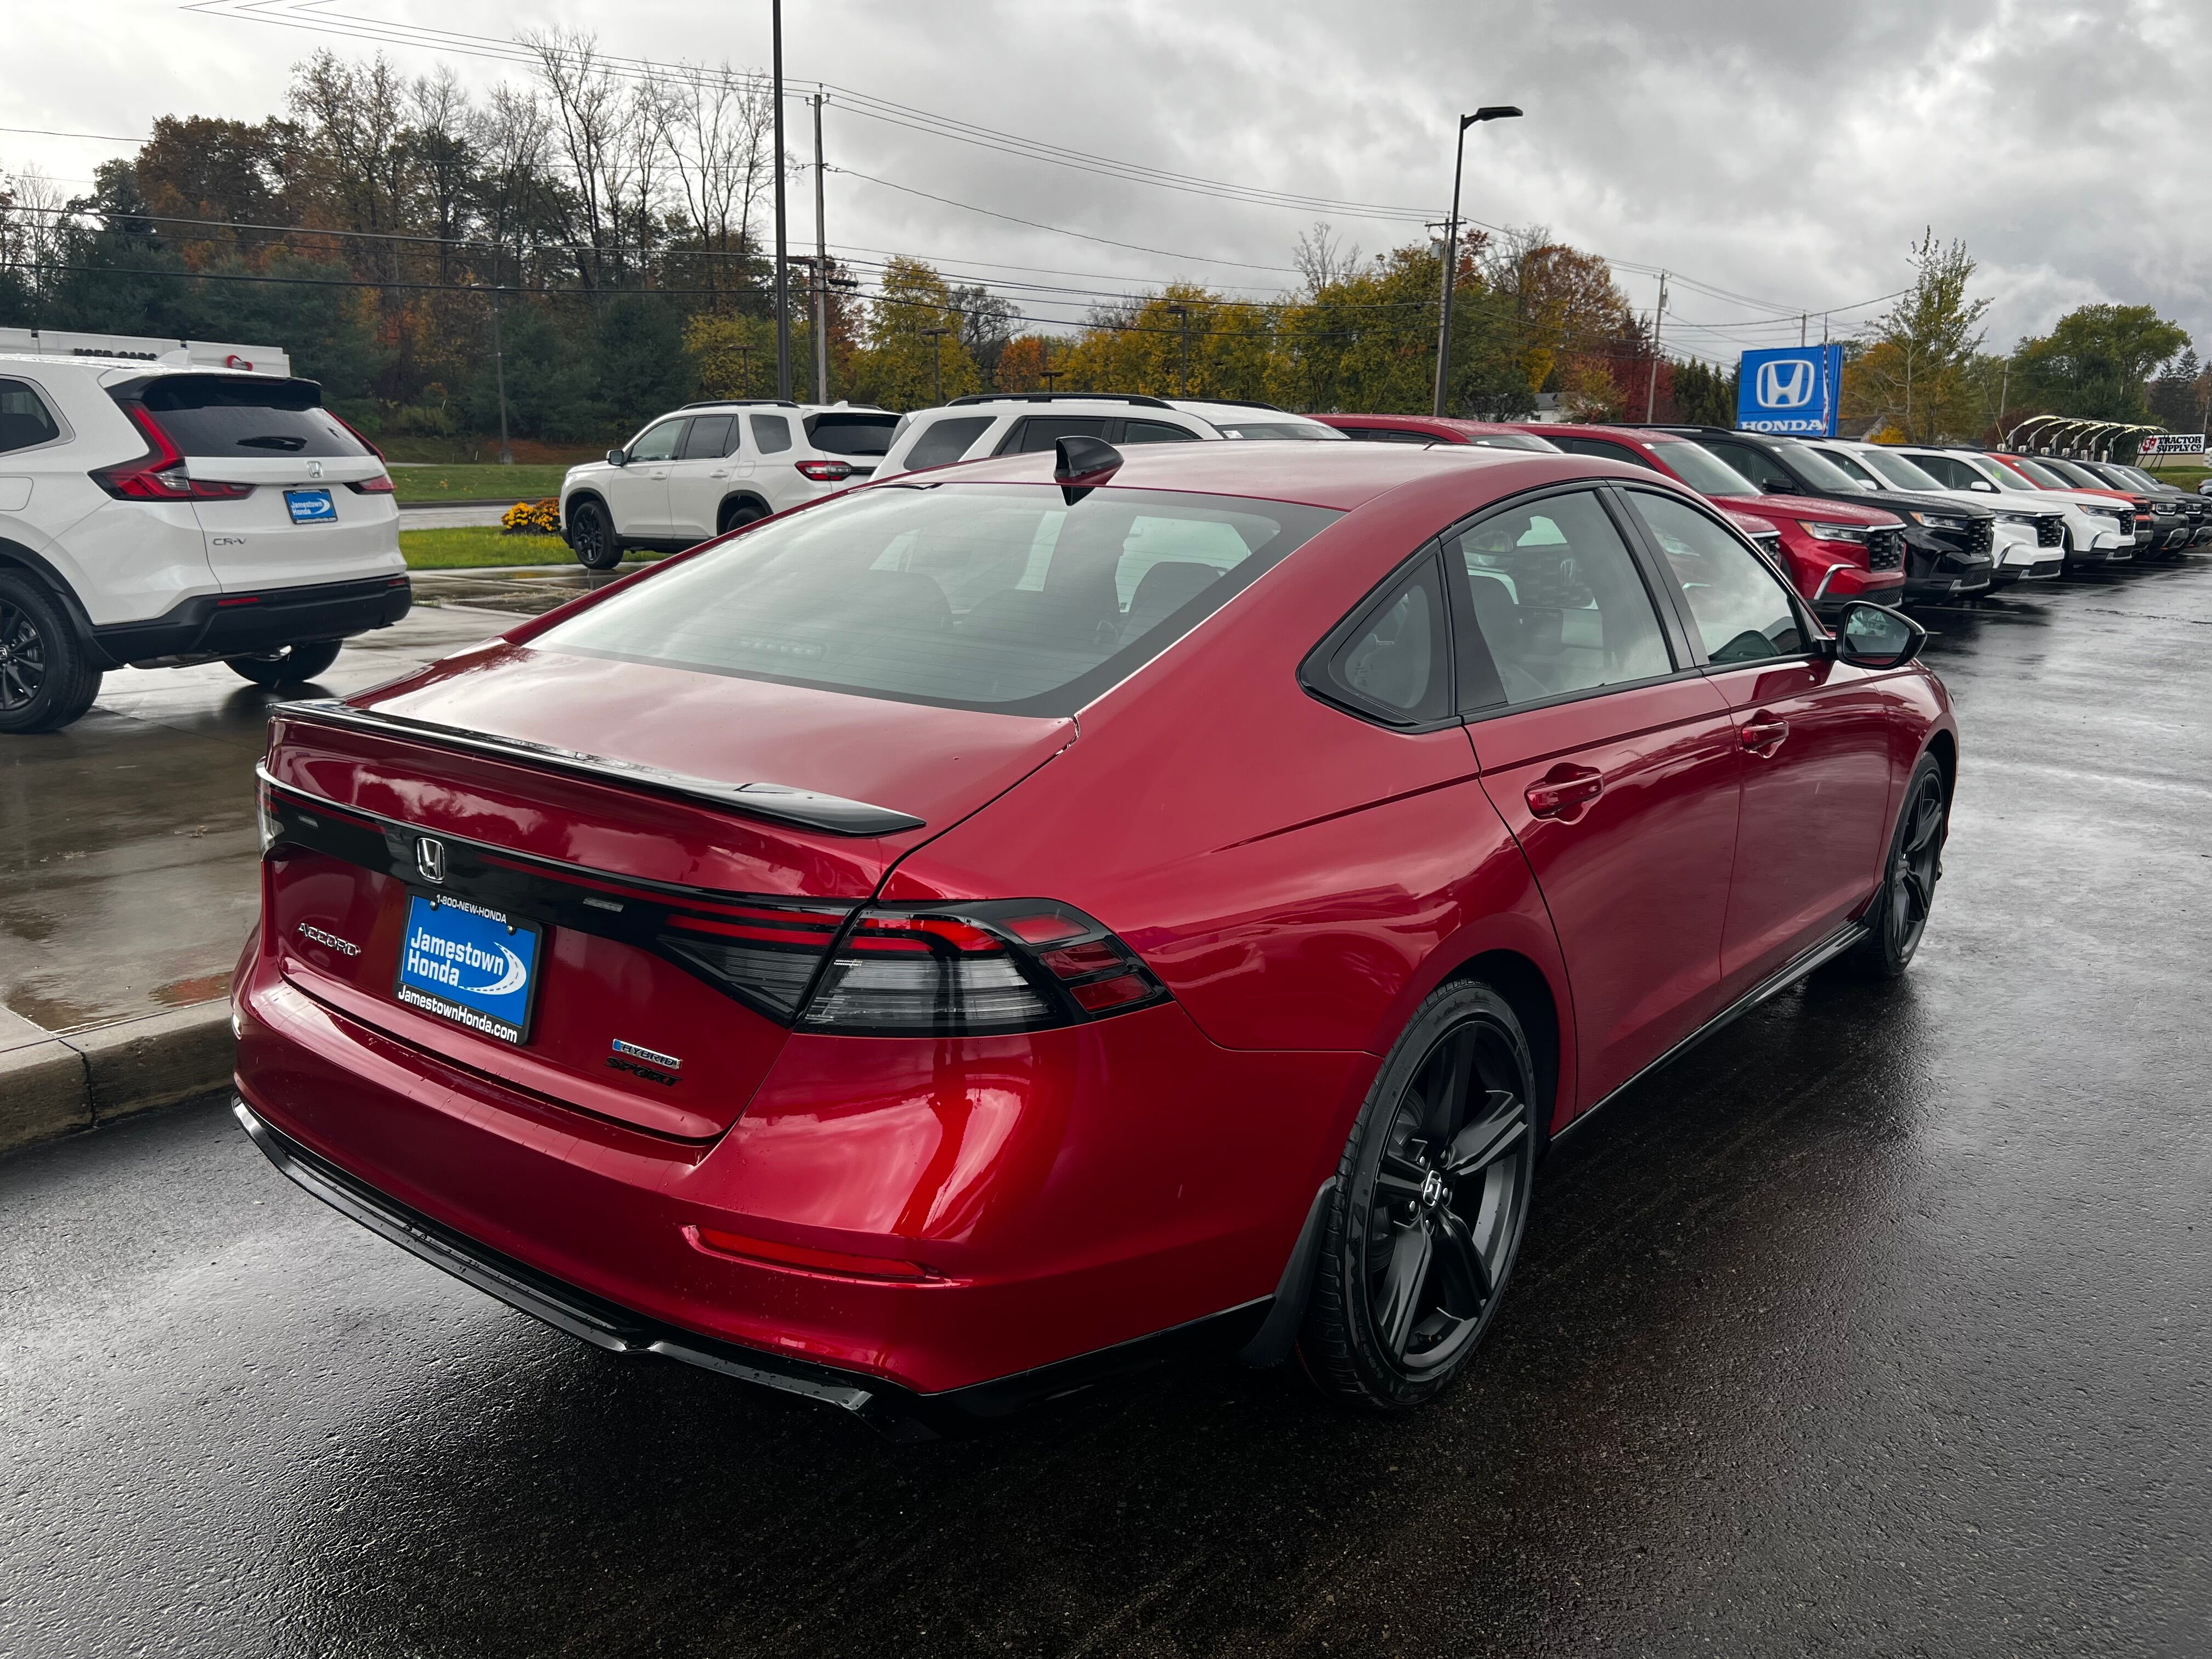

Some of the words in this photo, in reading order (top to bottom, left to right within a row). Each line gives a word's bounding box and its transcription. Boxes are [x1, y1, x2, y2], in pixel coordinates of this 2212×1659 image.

[1740, 419, 1823, 431] HONDA
[437, 894, 507, 923] 1-800-NEW-HONDA
[298, 923, 361, 956] ACCORD
[411, 927, 504, 976] Jamestown
[407, 949, 459, 987] Honda
[398, 985, 517, 1043] JamestownHonda.com
[623, 1045, 674, 1066] HYBRID
[605, 1057, 684, 1086] SPORT
